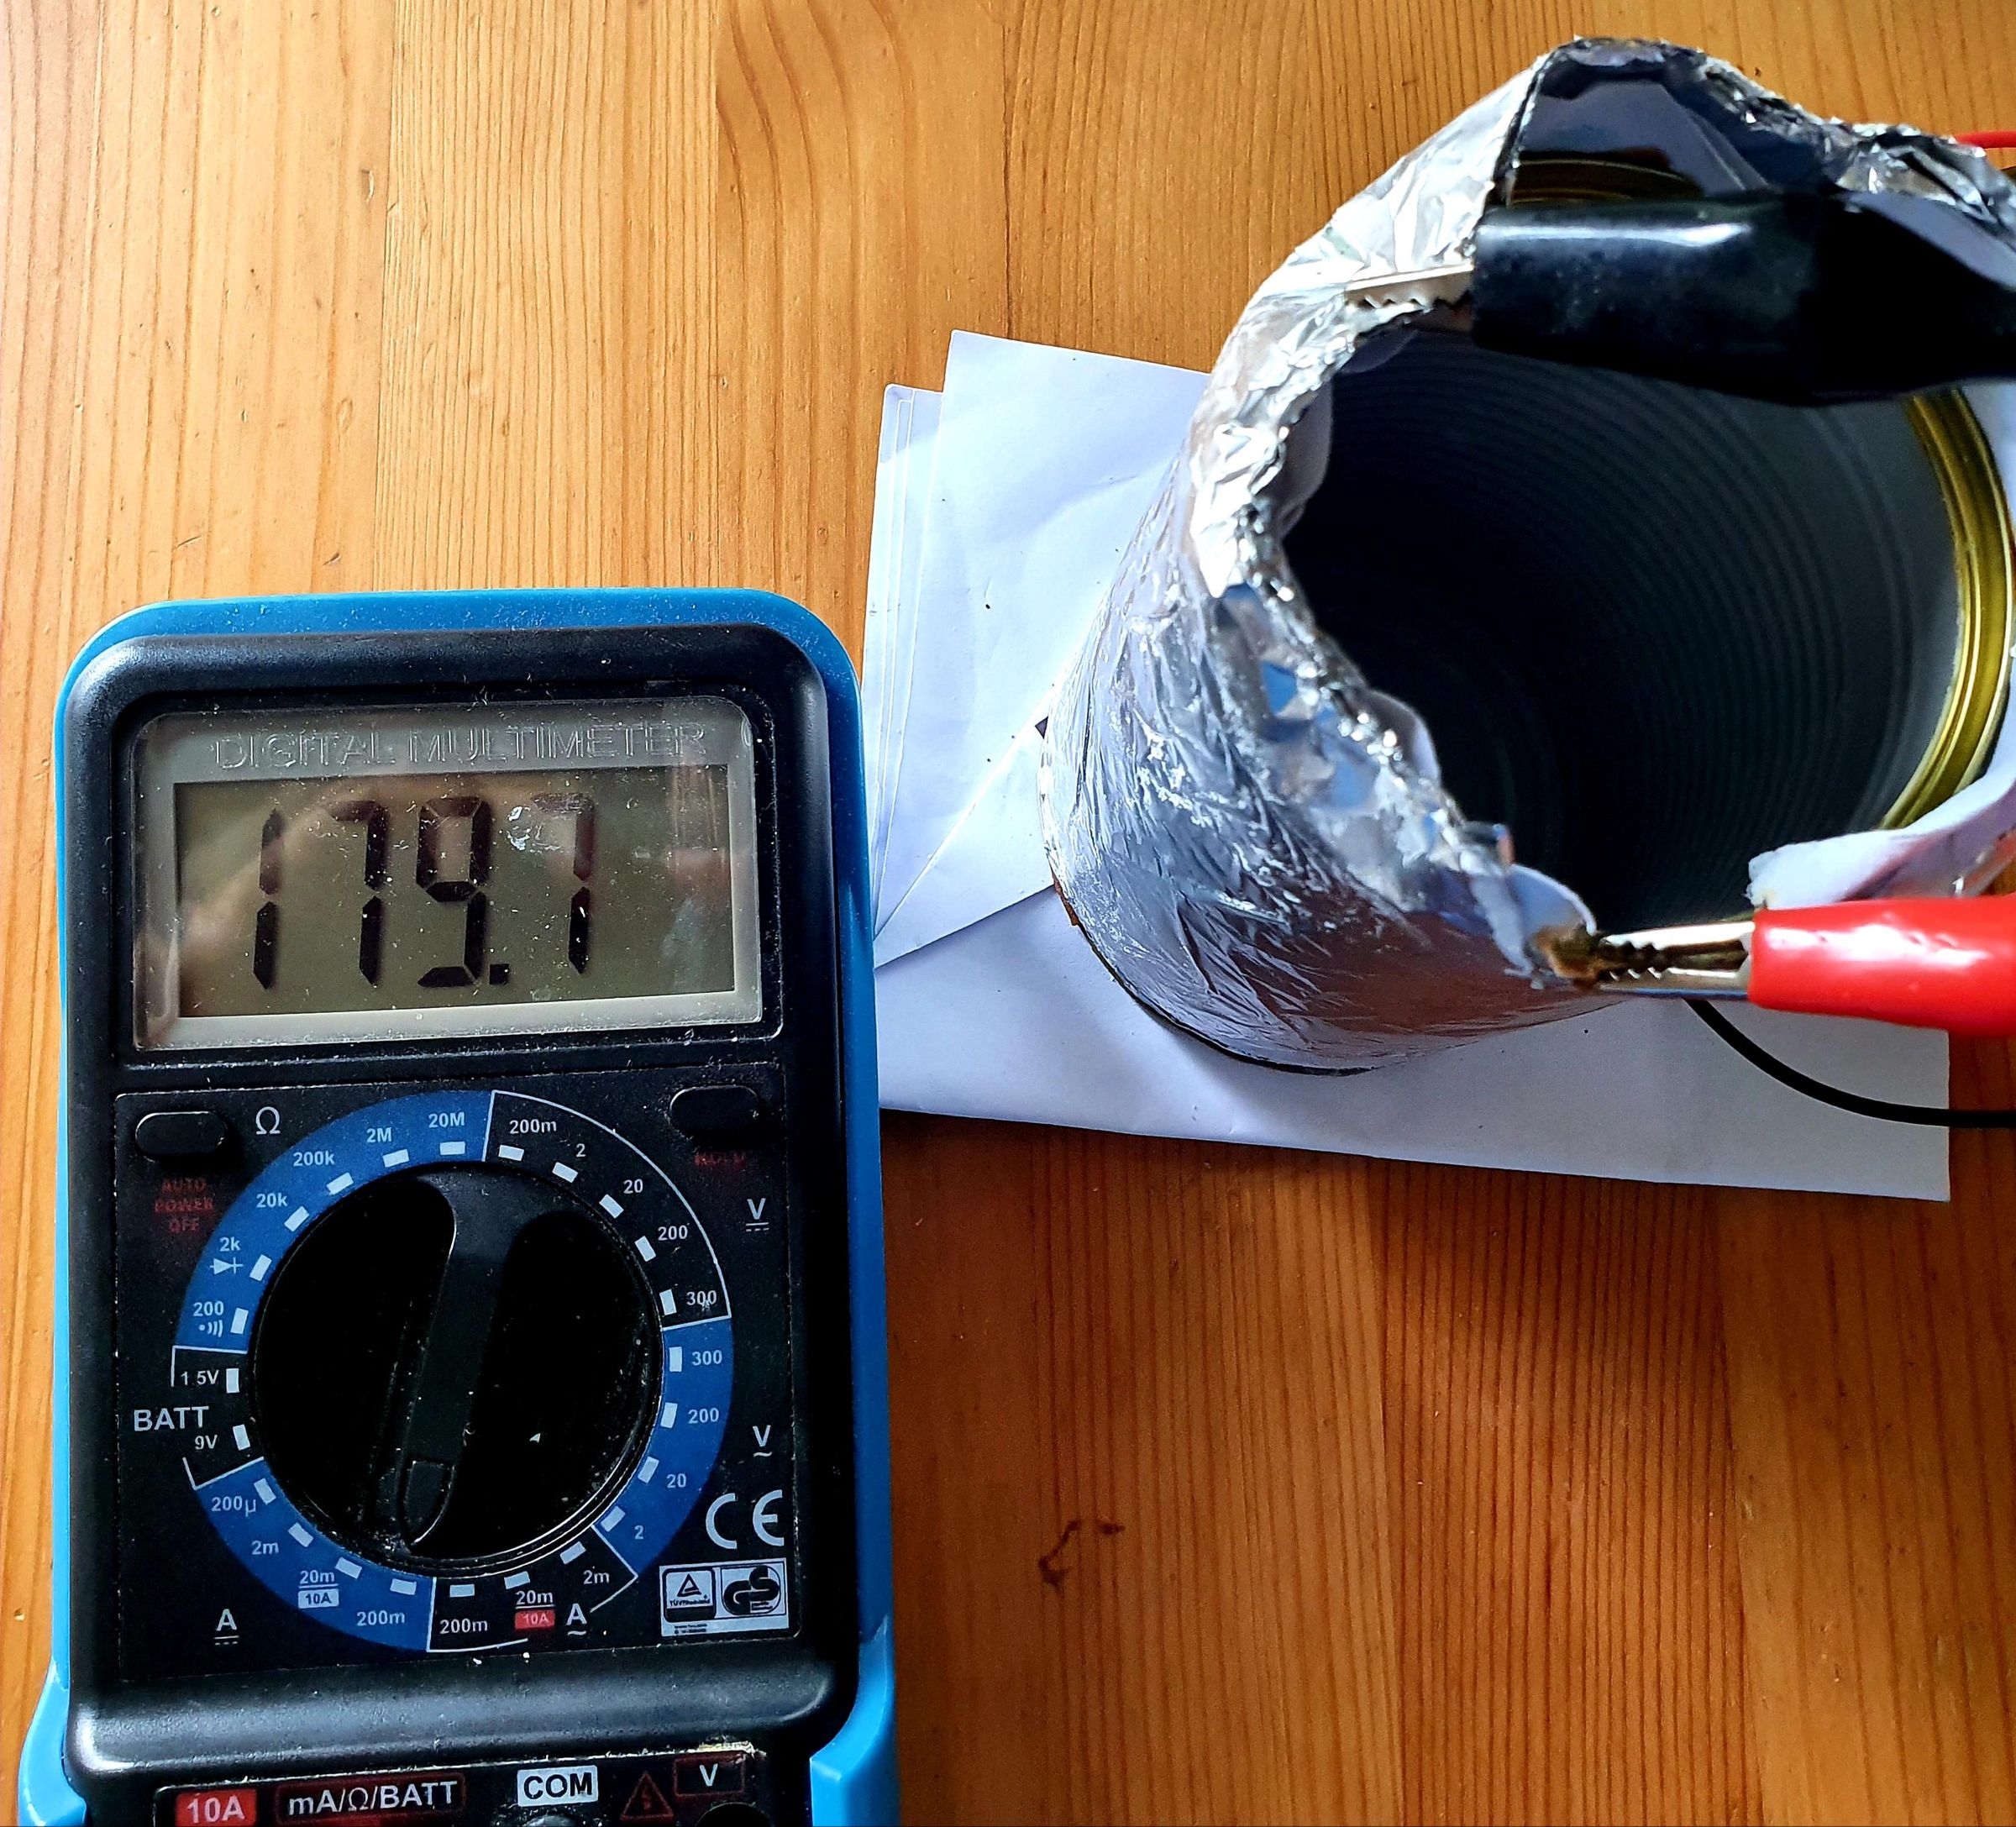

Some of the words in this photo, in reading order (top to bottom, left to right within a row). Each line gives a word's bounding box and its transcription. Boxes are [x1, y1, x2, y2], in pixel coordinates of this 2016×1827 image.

[214, 727, 396, 771] DIGITAL
[407, 722, 707, 764] MULTIMETER
[252, 793, 596, 990] 179.7
[428, 1111, 465, 1128] 20M
[509, 1118, 557, 1134] 200m
[366, 1127, 392, 1144] 2M
[575, 1143, 586, 1158] 2
[293, 1151, 335, 1168] 200k
[623, 1179, 643, 1194] 20
[256, 1193, 288, 1208] 20k
[657, 1225, 689, 1241] 200
[219, 1237, 241, 1252] 2k
[685, 1290, 717, 1307] 300
[193, 1300, 224, 1317] 200
[691, 1350, 723, 1367] 300
[134, 1405, 209, 1431] BATT
[688, 1408, 720, 1424] 200
[194, 1435, 218, 1451] 9V
[666, 1473, 687, 1488] 20
[633, 1525, 645, 1540] 2
[252, 1540, 280, 1555] 2m
[300, 1569, 335, 1584] 20m
[583, 1569, 610, 1585] 2m
[305, 1593, 333, 1606] 10A
[516, 1589, 553, 1605] 20m
[356, 1610, 406, 1626] 200m
[522, 1613, 549, 1625] 10A
[439, 1618, 488, 1635] 200m
[699, 1763, 718, 1787] V
[523, 1772, 593, 1800] COM
[187, 1794, 245, 1824] 10A
